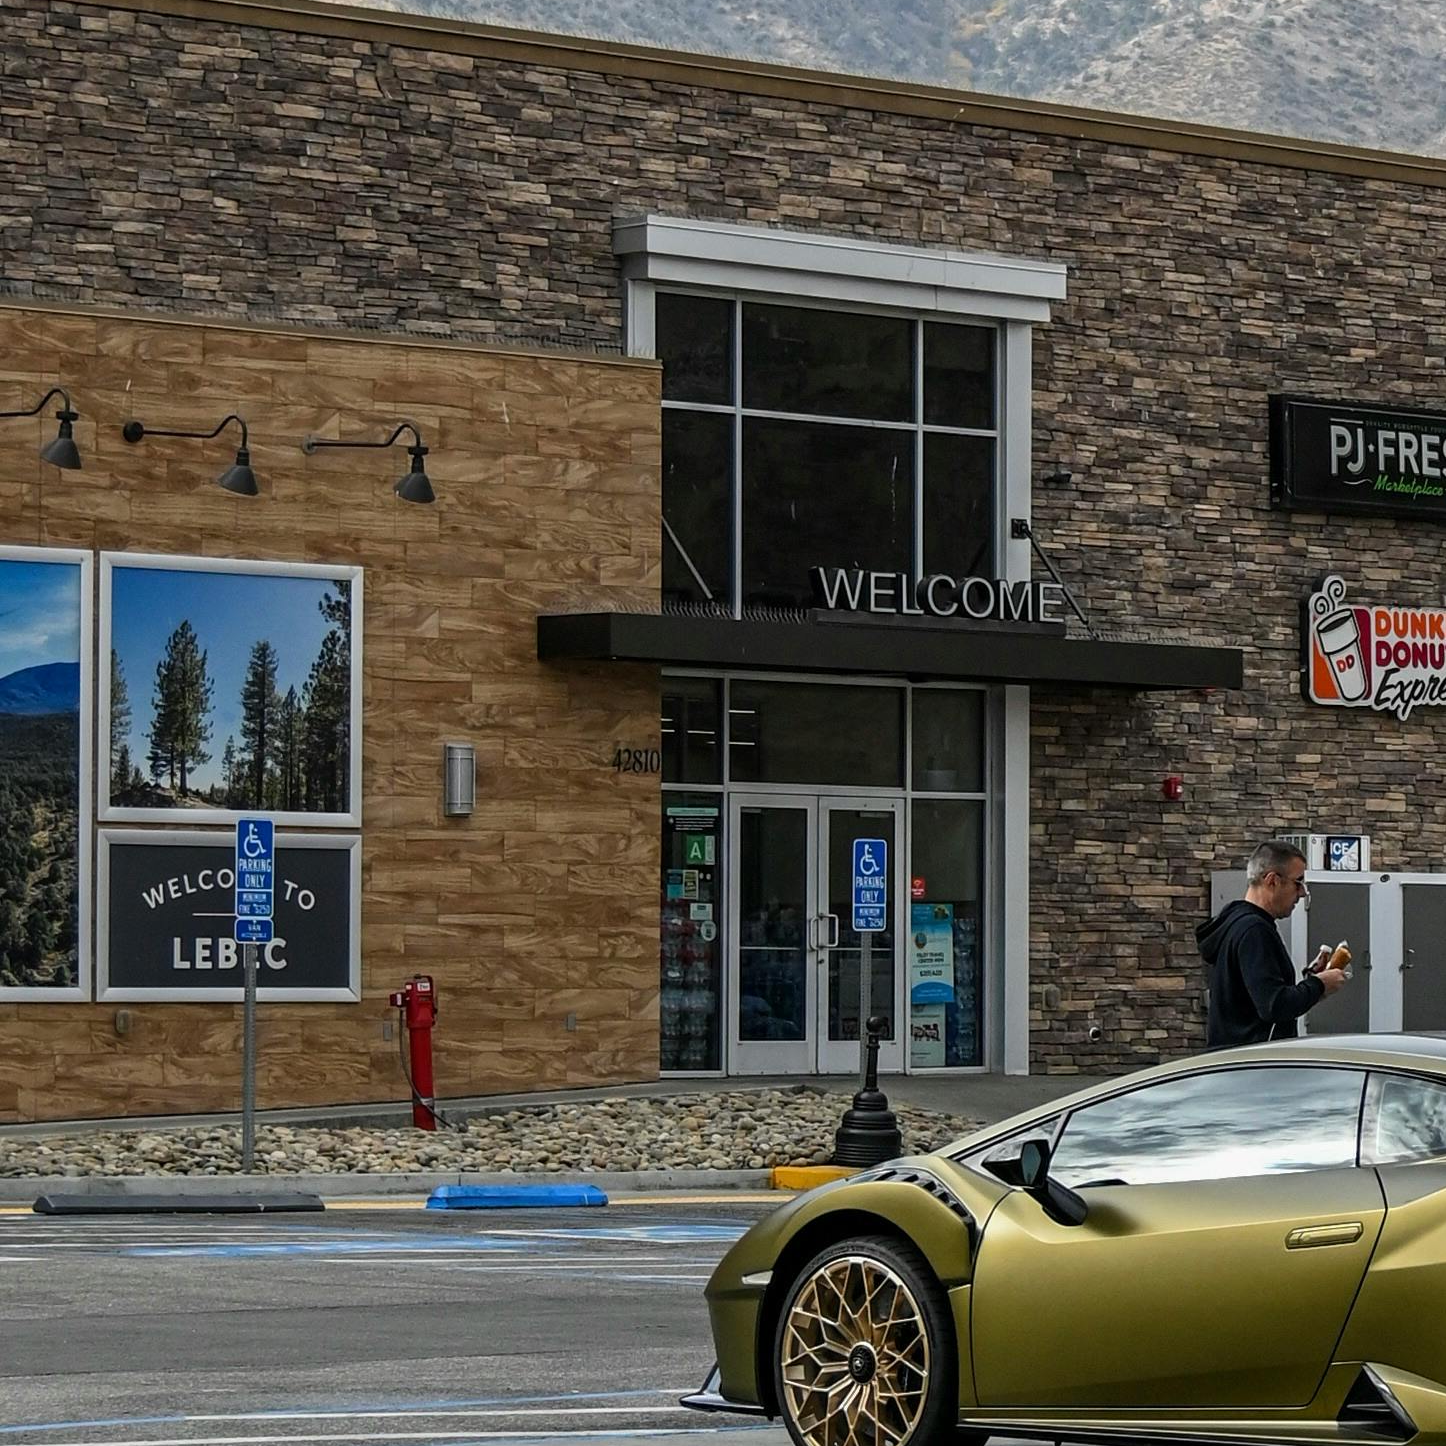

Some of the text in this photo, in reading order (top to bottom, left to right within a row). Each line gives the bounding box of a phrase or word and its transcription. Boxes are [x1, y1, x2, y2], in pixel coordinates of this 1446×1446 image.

[1373, 473, 1445, 500] Marketplace
[818, 567, 1065, 623] WELCOME
[1336, 654, 1355, 673] DD
[612, 748, 661, 774] 42810
[690, 843, 702, 859] A
[239, 858, 272, 872] PARKING
[142, 868, 316, 911] WELCO TO
[244, 874, 266, 888] ONLY
[856, 876, 885, 890] PARKING
[861, 890, 879, 903] ONLY
